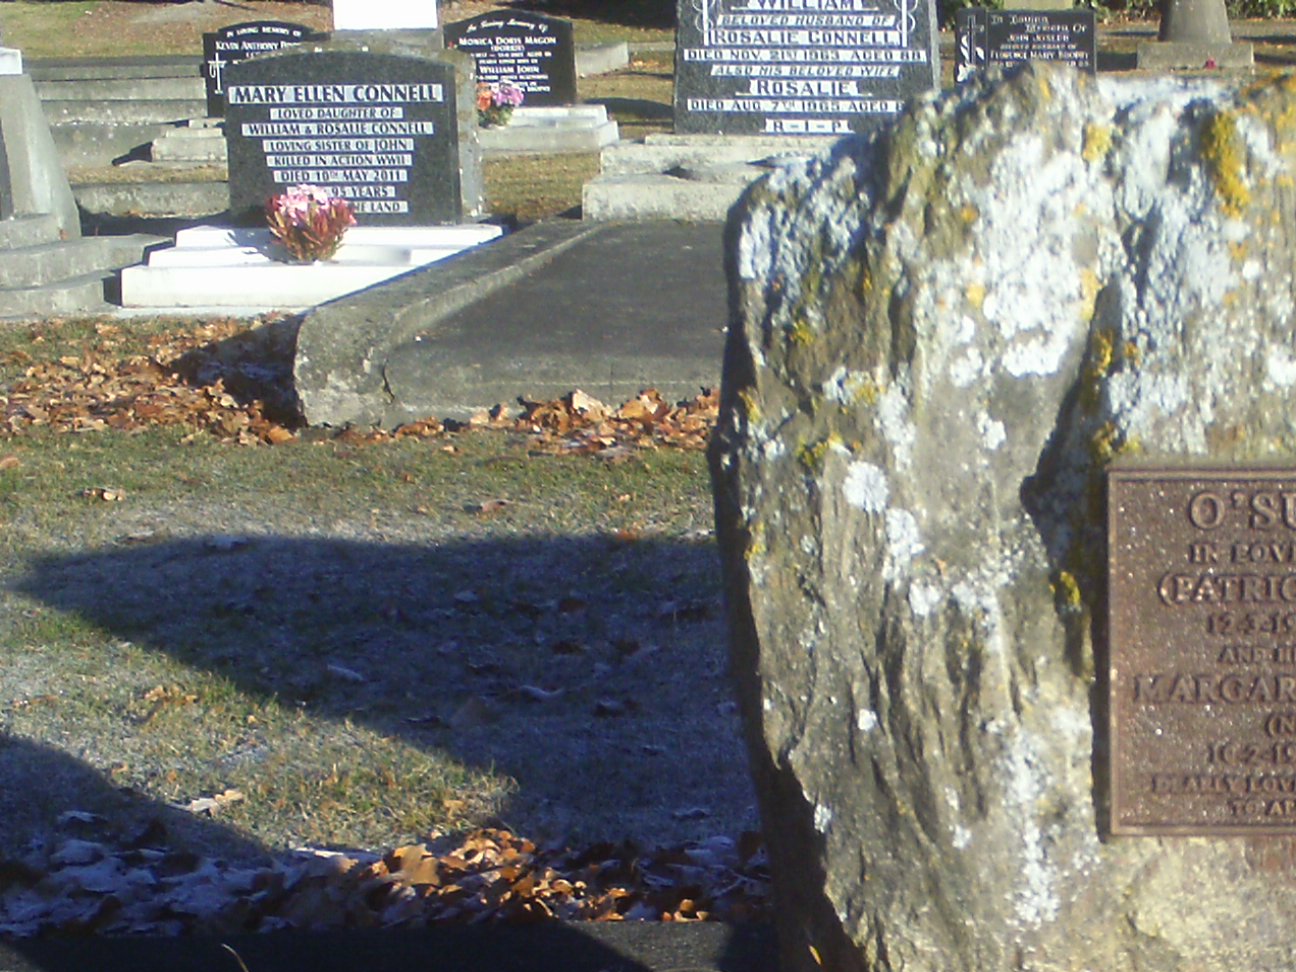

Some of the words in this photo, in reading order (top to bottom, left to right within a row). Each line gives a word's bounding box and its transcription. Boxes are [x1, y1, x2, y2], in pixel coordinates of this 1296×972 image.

[721, 15, 789, 26] BELOVED
[796, 15, 864, 26] HUSBAND
[871, 15, 888, 26] OF
[459, 37, 493, 46] MONICA
[495, 36, 522, 45] DORIS
[524, 36, 557, 44] MAGON
[714, 30, 799, 44] ROSALIE
[215, 41, 239, 51] KEVIN
[241, 41, 279, 51] ANTHONY
[688, 50, 723, 60] DIED
[851, 51, 893, 61] AGED
[479, 65, 516, 74] WILLIAM
[517, 65, 540, 74] JOHN
[715, 66, 753, 76] ALSO
[759, 66, 782, 76] HIS
[789, 66, 854, 77] BELOVED
[860, 66, 893, 77] WIFE
[234, 86, 286, 102] MARY
[293, 86, 345, 102] ELLEN
[353, 85, 438, 101] CONNELL
[757, 80, 849, 95] ROSALIE
[691, 101, 724, 111] DIED
[849, 101, 889, 112] AGED
[277, 108, 313, 119] LOVED
[317, 108, 377, 119] DAUGHTER
[380, 107, 396, 118] OF
[248, 124, 301, 135] WILLIAM
[304, 124, 313, 135] &
[317, 123, 368, 135] ROSALIE
[371, 122, 425, 134] CONNELL
[270, 141, 312, 152] LOVING
[315, 140, 352, 151] SISTER
[355, 140, 369, 151] OF
[373, 139, 407, 153] JOHN
[274, 156, 310, 166] KILLED
[315, 156, 328, 166] IN
[331, 155, 373, 165] ACTION
[376, 154, 406, 165] WWII
[281, 171, 310, 182] DIED
[343, 170, 369, 181] MAY
[373, 170, 401, 181] 2011
[331, 187, 346, 198] 95
[351, 186, 388, 198] YEARS
[371, 201, 400, 213] LAND
[1188, 543, 1219, 564] IN
[1217, 645, 1264, 664] AND
[1151, 773, 1244, 794] DEARLY
[1228, 799, 1260, 817] TO
